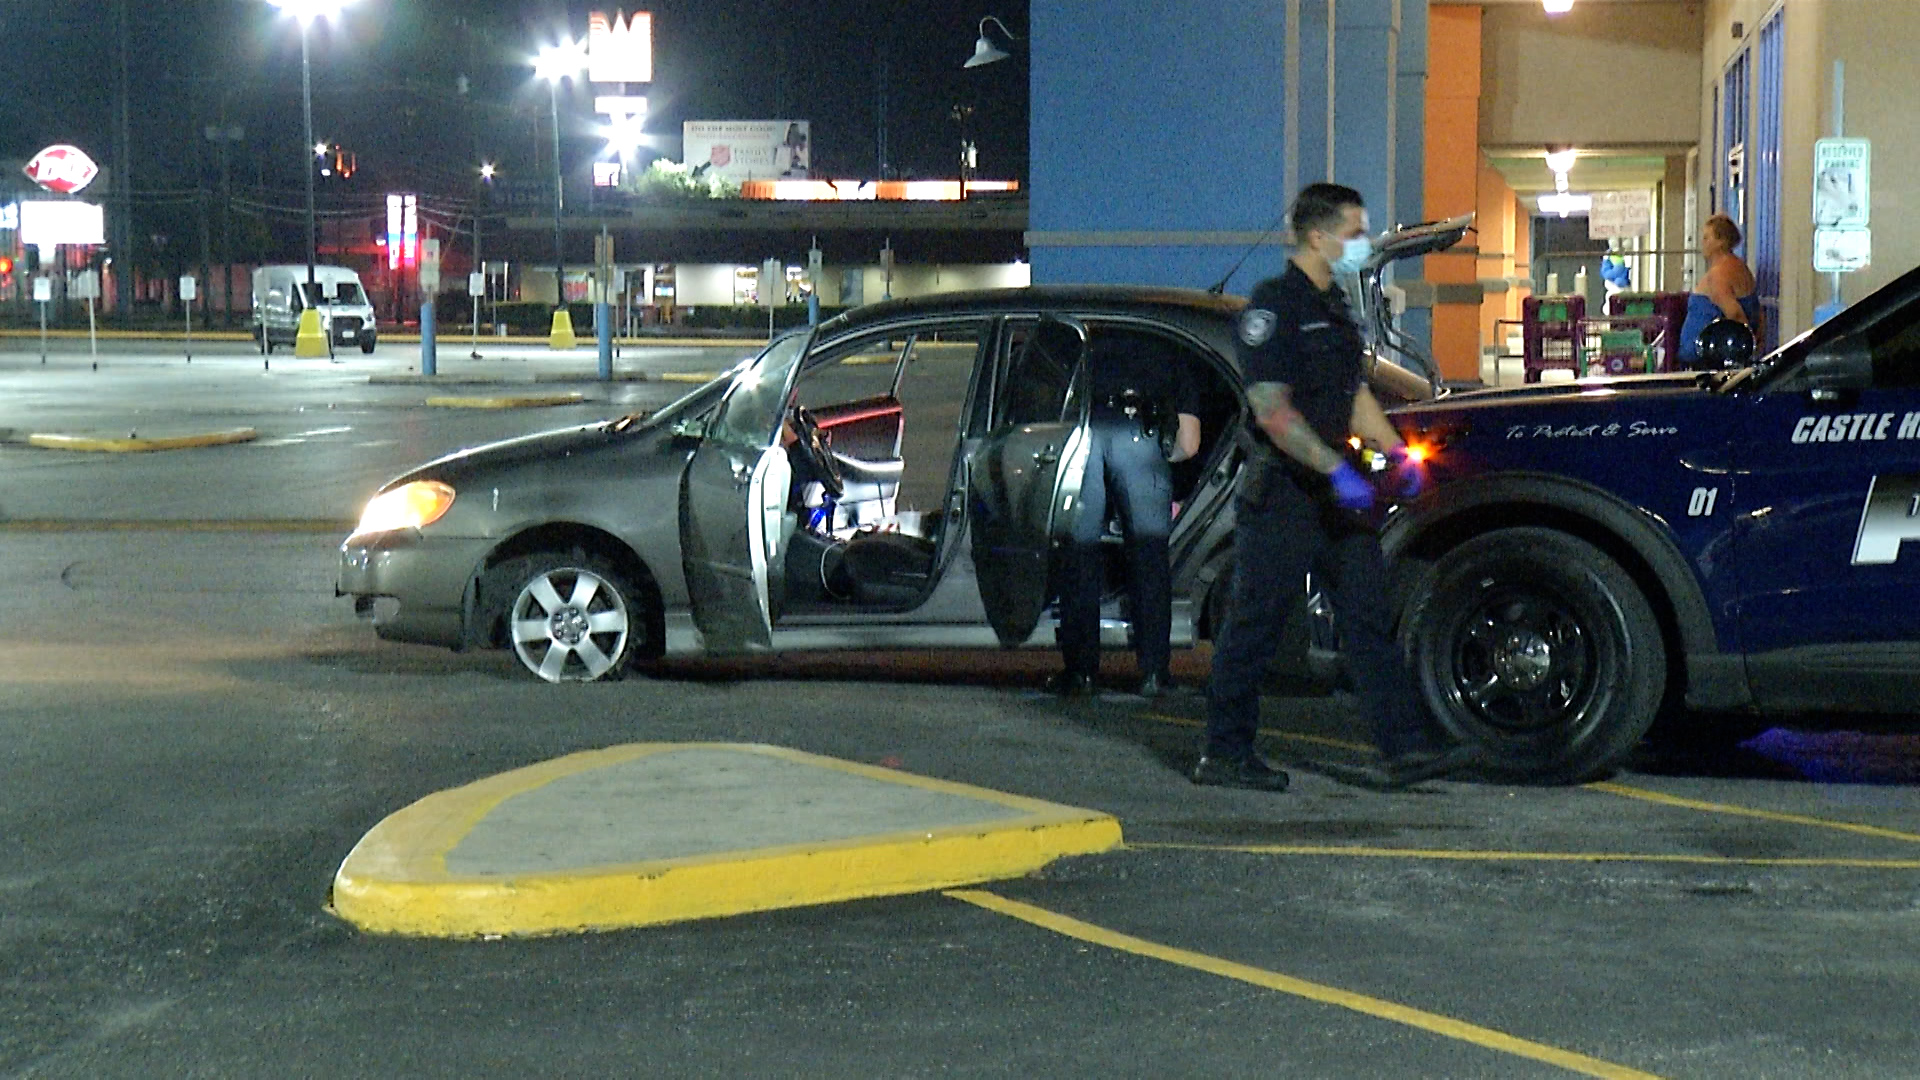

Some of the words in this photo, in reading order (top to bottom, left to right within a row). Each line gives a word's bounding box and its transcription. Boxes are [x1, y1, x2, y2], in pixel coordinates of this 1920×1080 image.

[1821, 147, 1864, 158] RESERVED
[1791, 412, 1896, 444] CASTLE
[1687, 486, 1719, 517] 01
